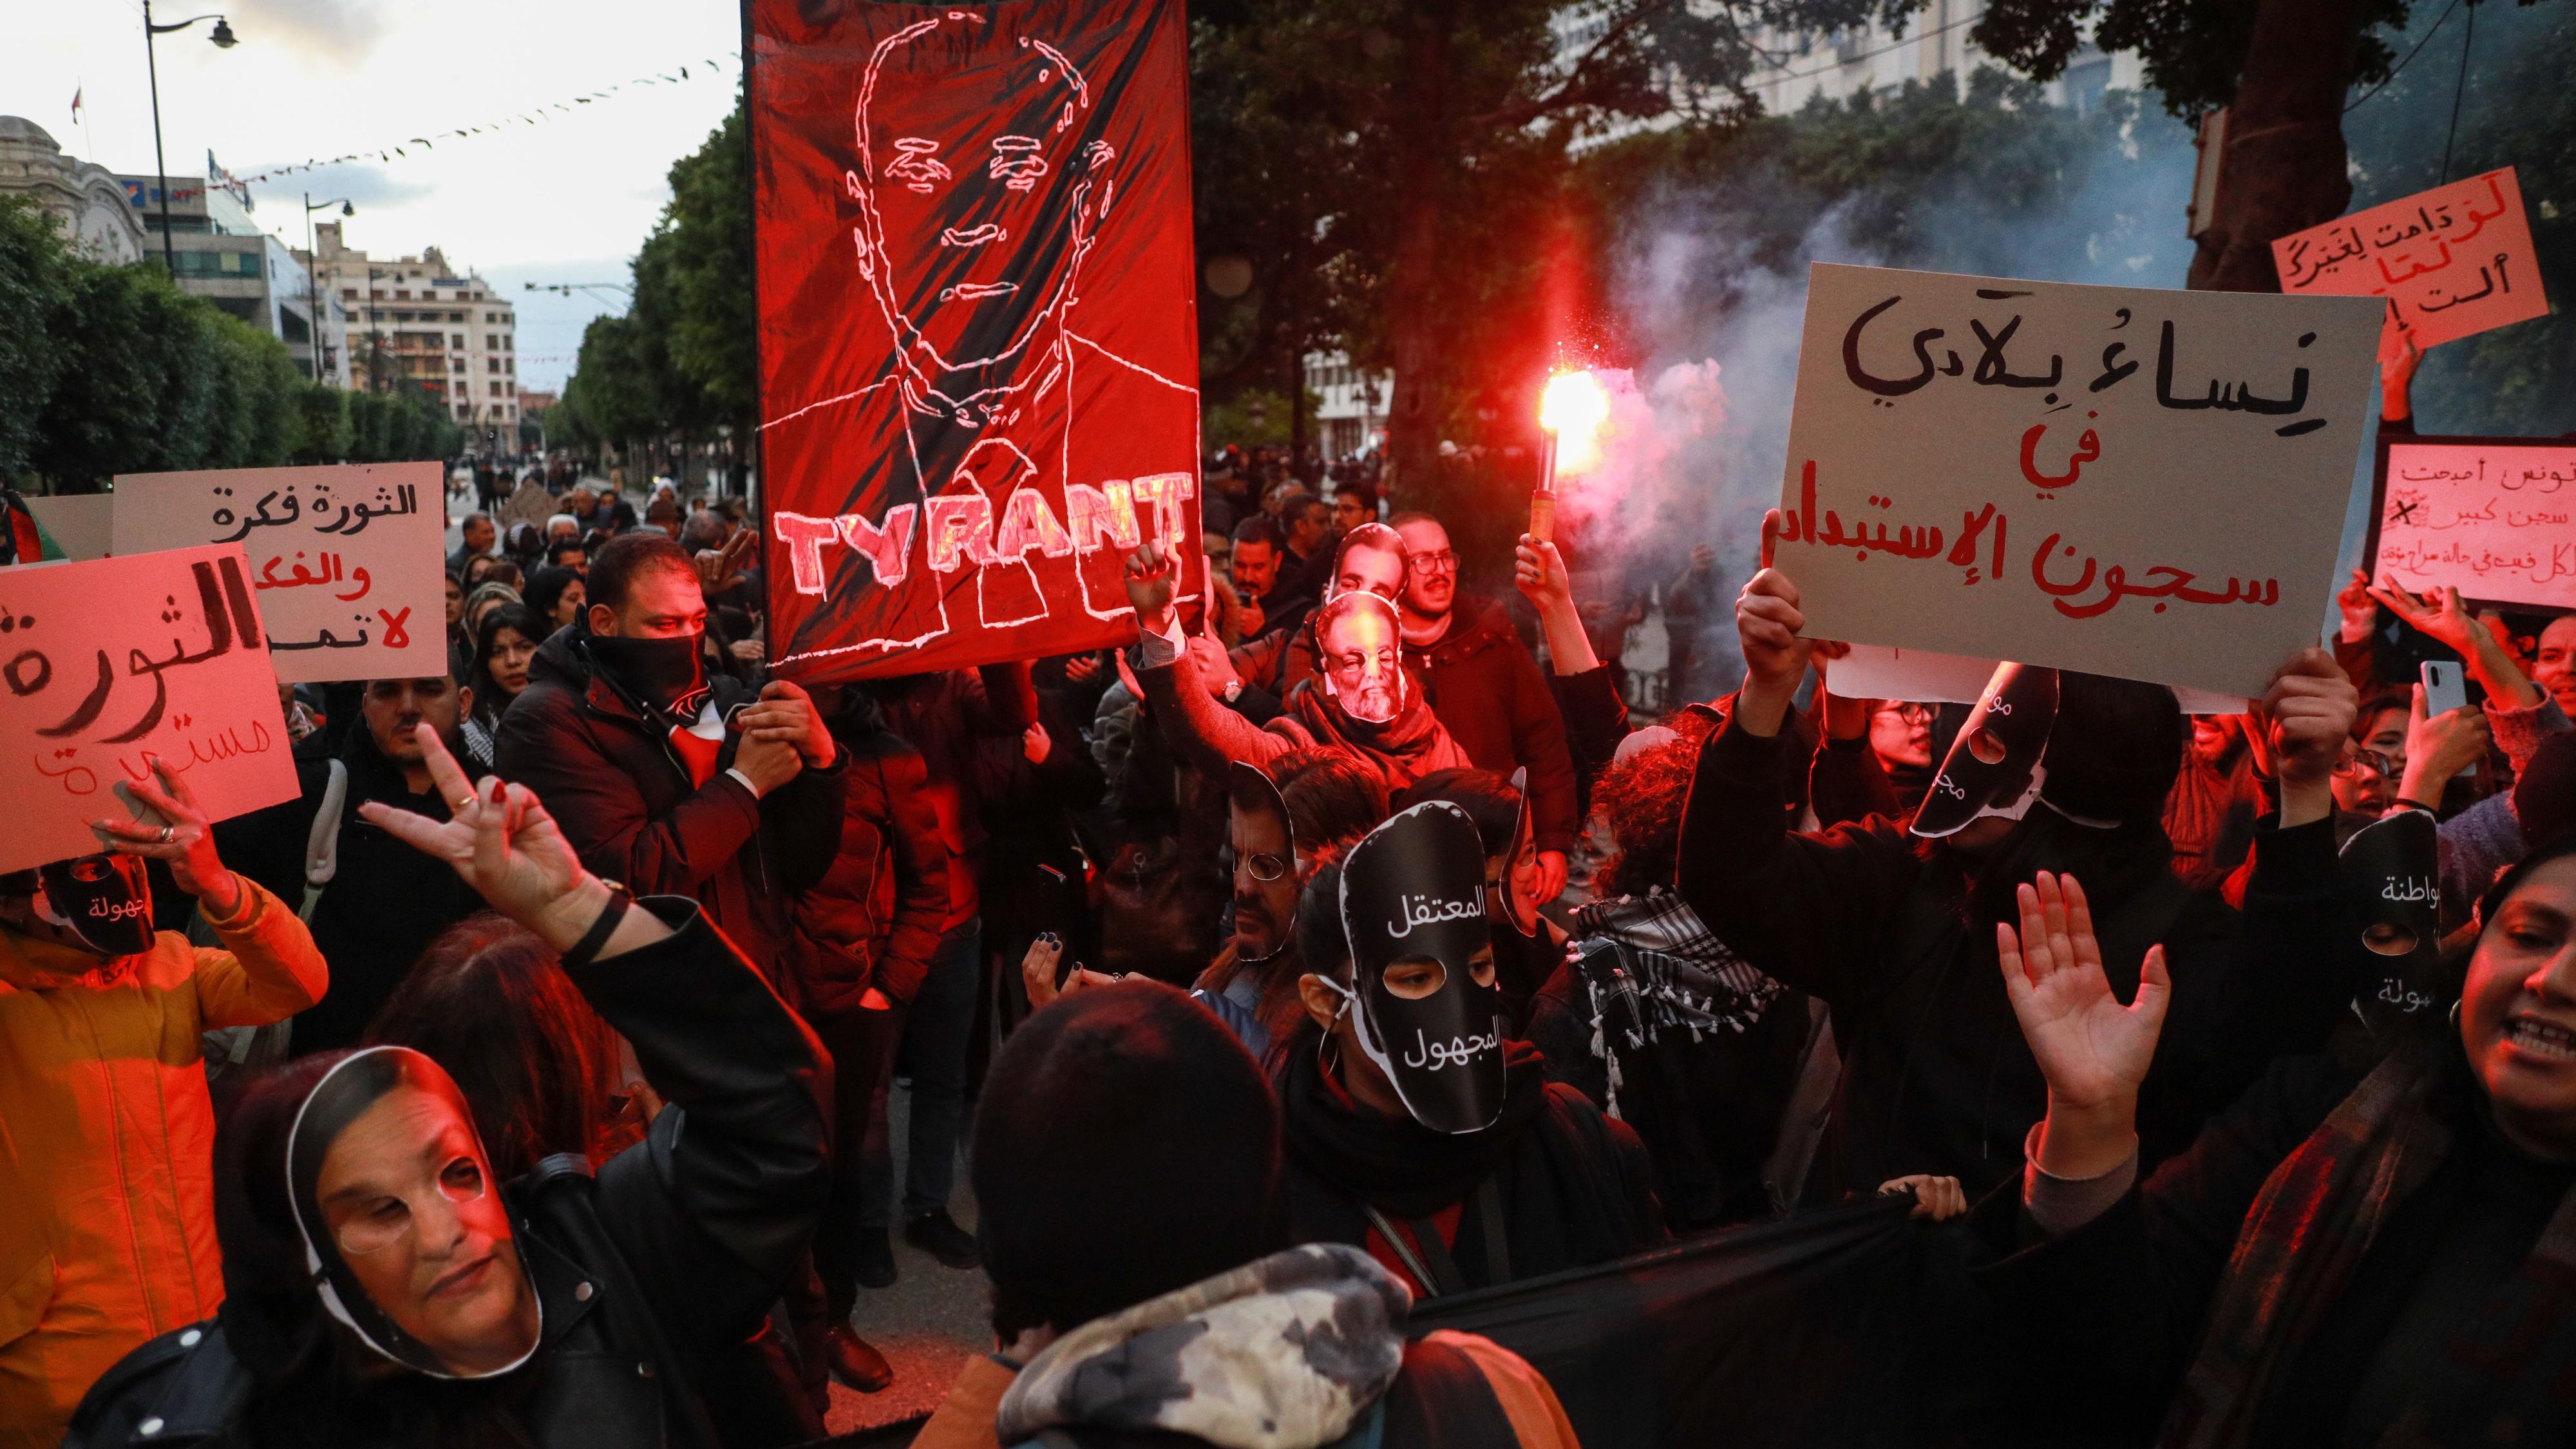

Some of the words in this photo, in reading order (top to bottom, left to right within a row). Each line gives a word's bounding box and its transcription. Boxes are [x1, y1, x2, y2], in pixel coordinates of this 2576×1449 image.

[2020, 410, 2101, 500] في
[210, 485, 300, 544] فكرة
[312, 484, 417, 536] الثورة
[773, 472, 1194, 596] TYRANT
[1777, 459, 2007, 586] الإستبداد
[2430, 497, 2497, 530] كبير
[255, 551, 371, 601] والفك
[2032, 532, 2280, 620] سجون
[1, 556, 261, 744] الثورة
[377, 606, 412, 649] لا
[88, 896, 146, 922] جهولة
[1388, 884, 1486, 938] المعتقل
[1404, 1014, 1501, 1071] المجهول
